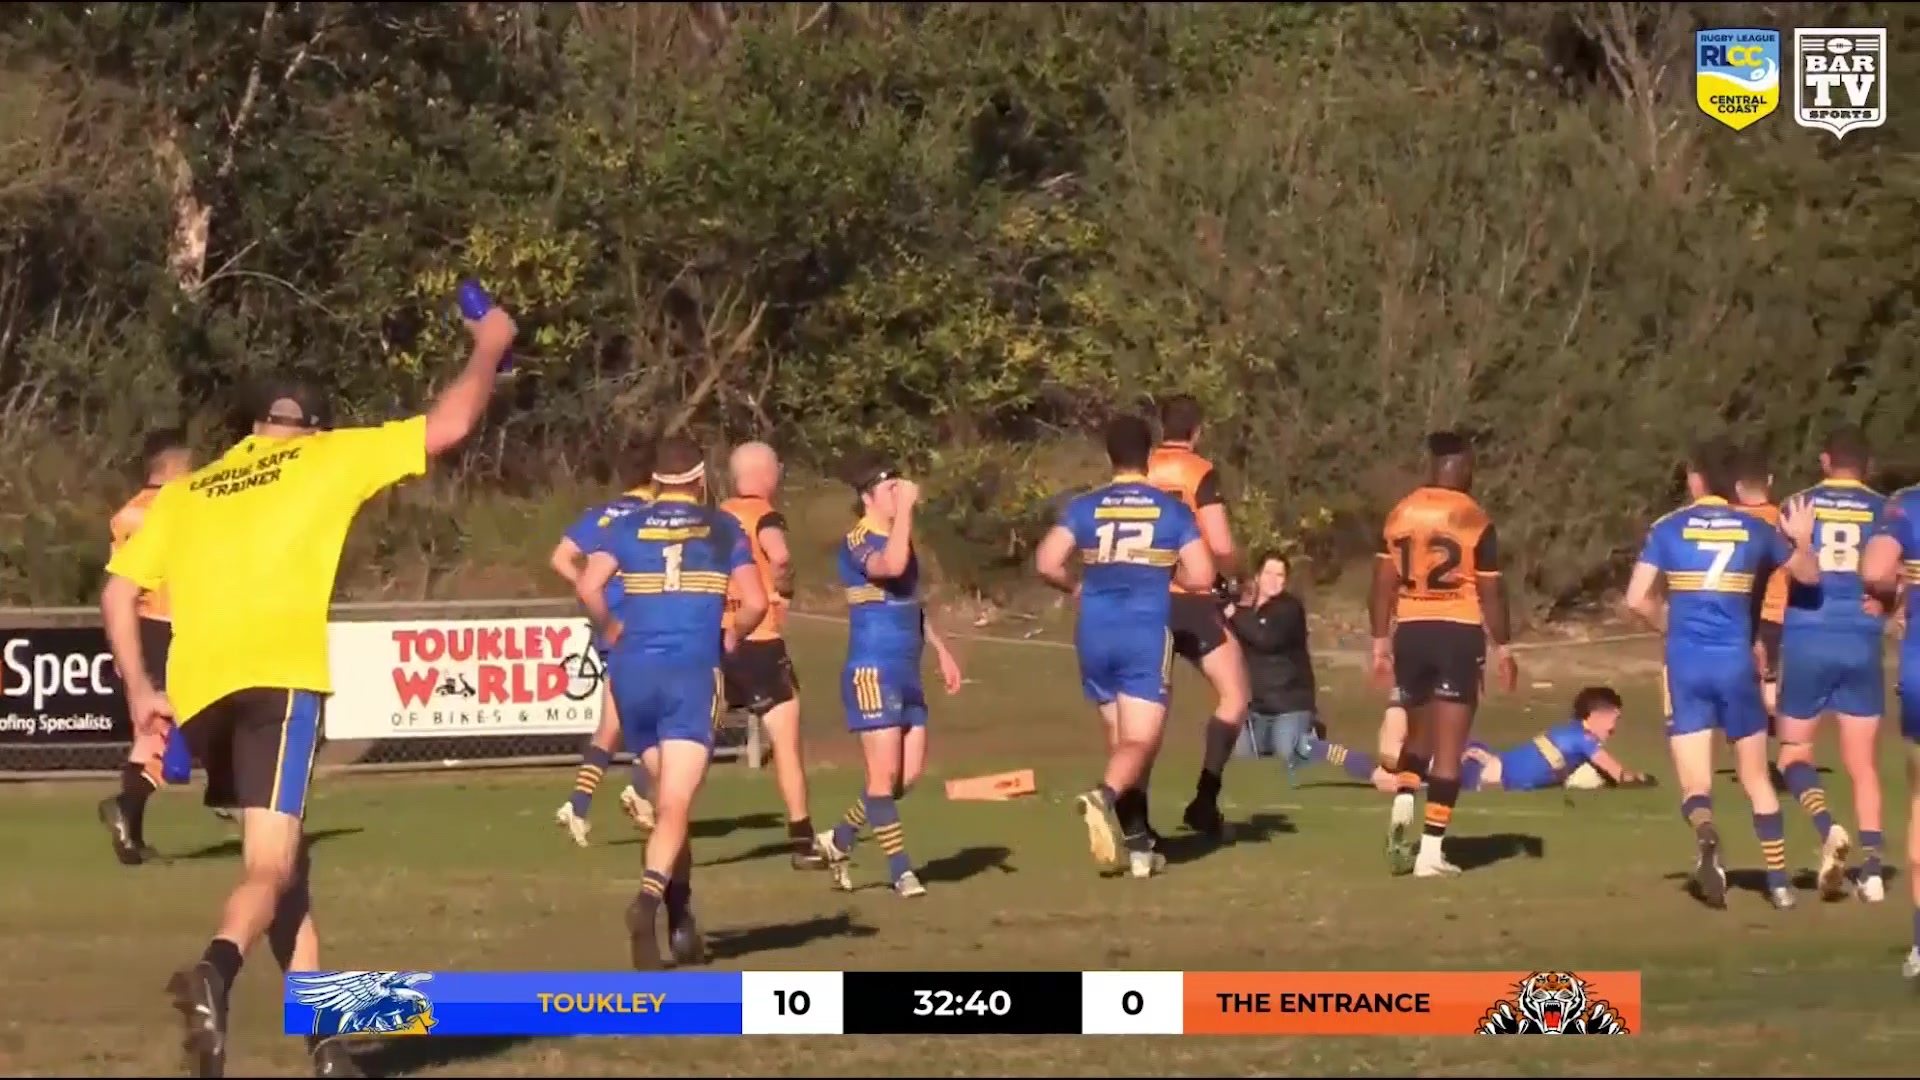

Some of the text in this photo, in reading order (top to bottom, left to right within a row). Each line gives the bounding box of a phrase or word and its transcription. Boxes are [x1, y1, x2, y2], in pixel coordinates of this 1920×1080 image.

[206, 467, 282, 498] TRAINER
[1094, 521, 1155, 564] 12
[1392, 535, 1463, 590] 12
[1697, 541, 1736, 591] 7
[1818, 522, 1862, 572] 8
[662, 543, 684, 592] 1
[391, 626, 572, 663] TOUKLEY
[3, 638, 114, 711] Spec
[391, 663, 570, 710] WRLD
[38, 712, 113, 736] Specialists
[391, 711, 419, 726] OF
[433, 709, 502, 725] BIKES
